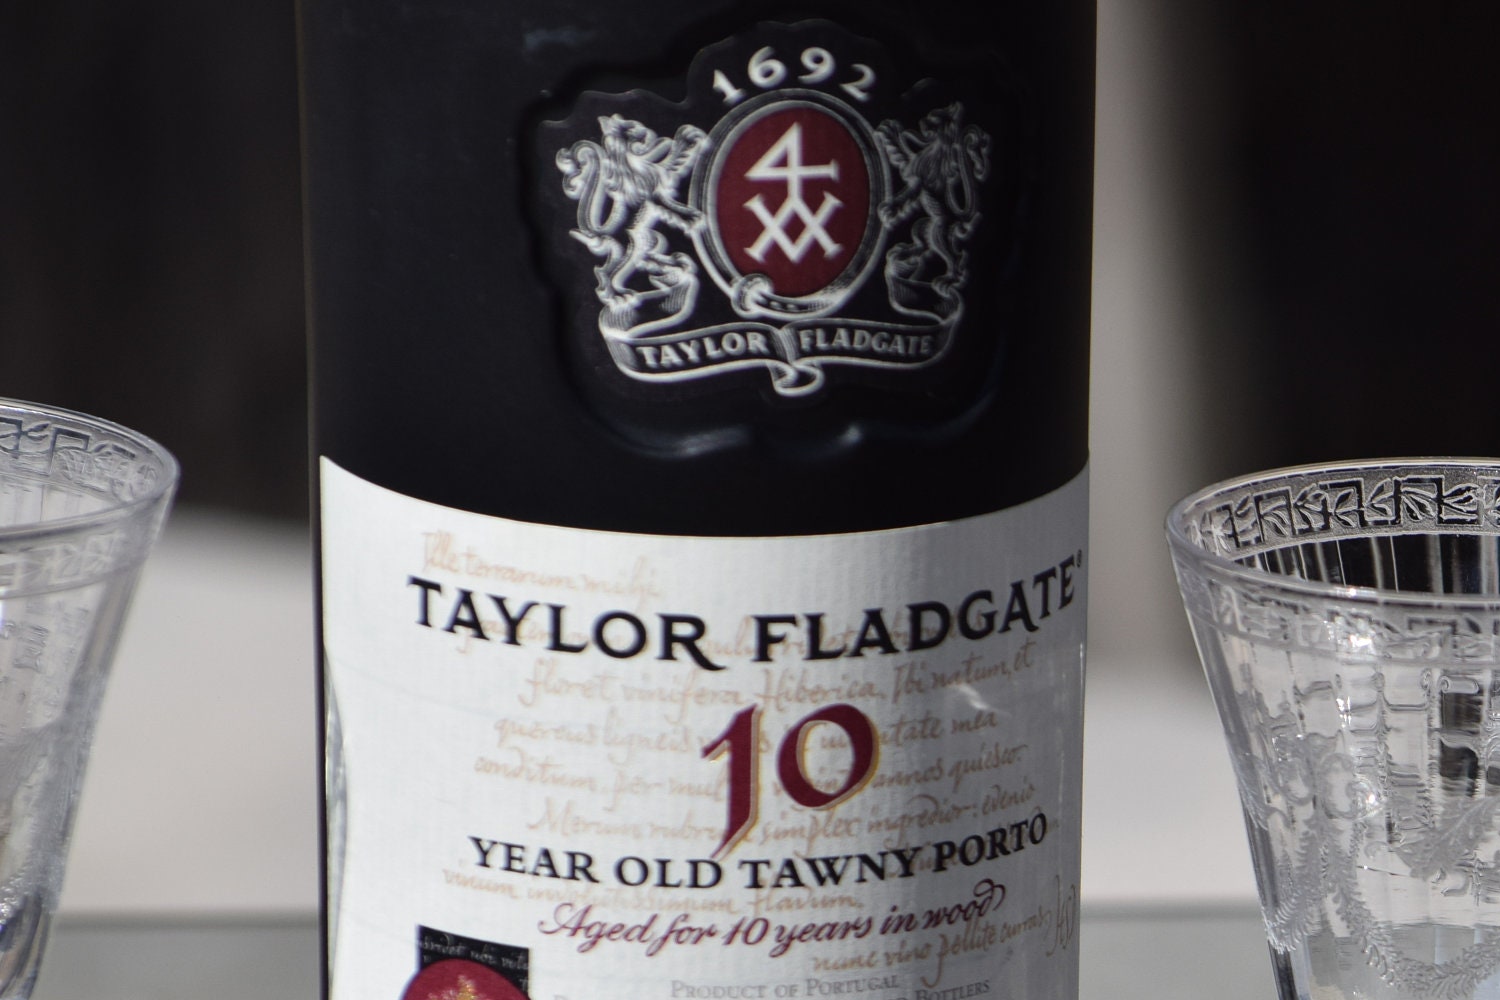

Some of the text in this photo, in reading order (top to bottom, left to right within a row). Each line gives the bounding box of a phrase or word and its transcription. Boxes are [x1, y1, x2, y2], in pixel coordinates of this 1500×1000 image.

[713, 46, 876, 105] 1692
[635, 328, 932, 368] TAYLOR FLADGATE
[407, 575, 727, 672] TAYLOR
[701, 703, 880, 862] 10
[467, 835, 600, 884] YEAR
[614, 856, 724, 888] OLD
[737, 845, 924, 889] TAWNY
[932, 812, 1048, 873] PORTO
[538, 903, 658, 953] Aged
[646, 913, 717, 957] for
[722, 915, 771, 946] 10
[769, 915, 873, 958] years
[879, 904, 920, 935] in
[920, 877, 1006, 931] wood
[670, 975, 900, 999] PRODUCT OF PORTUGAL
